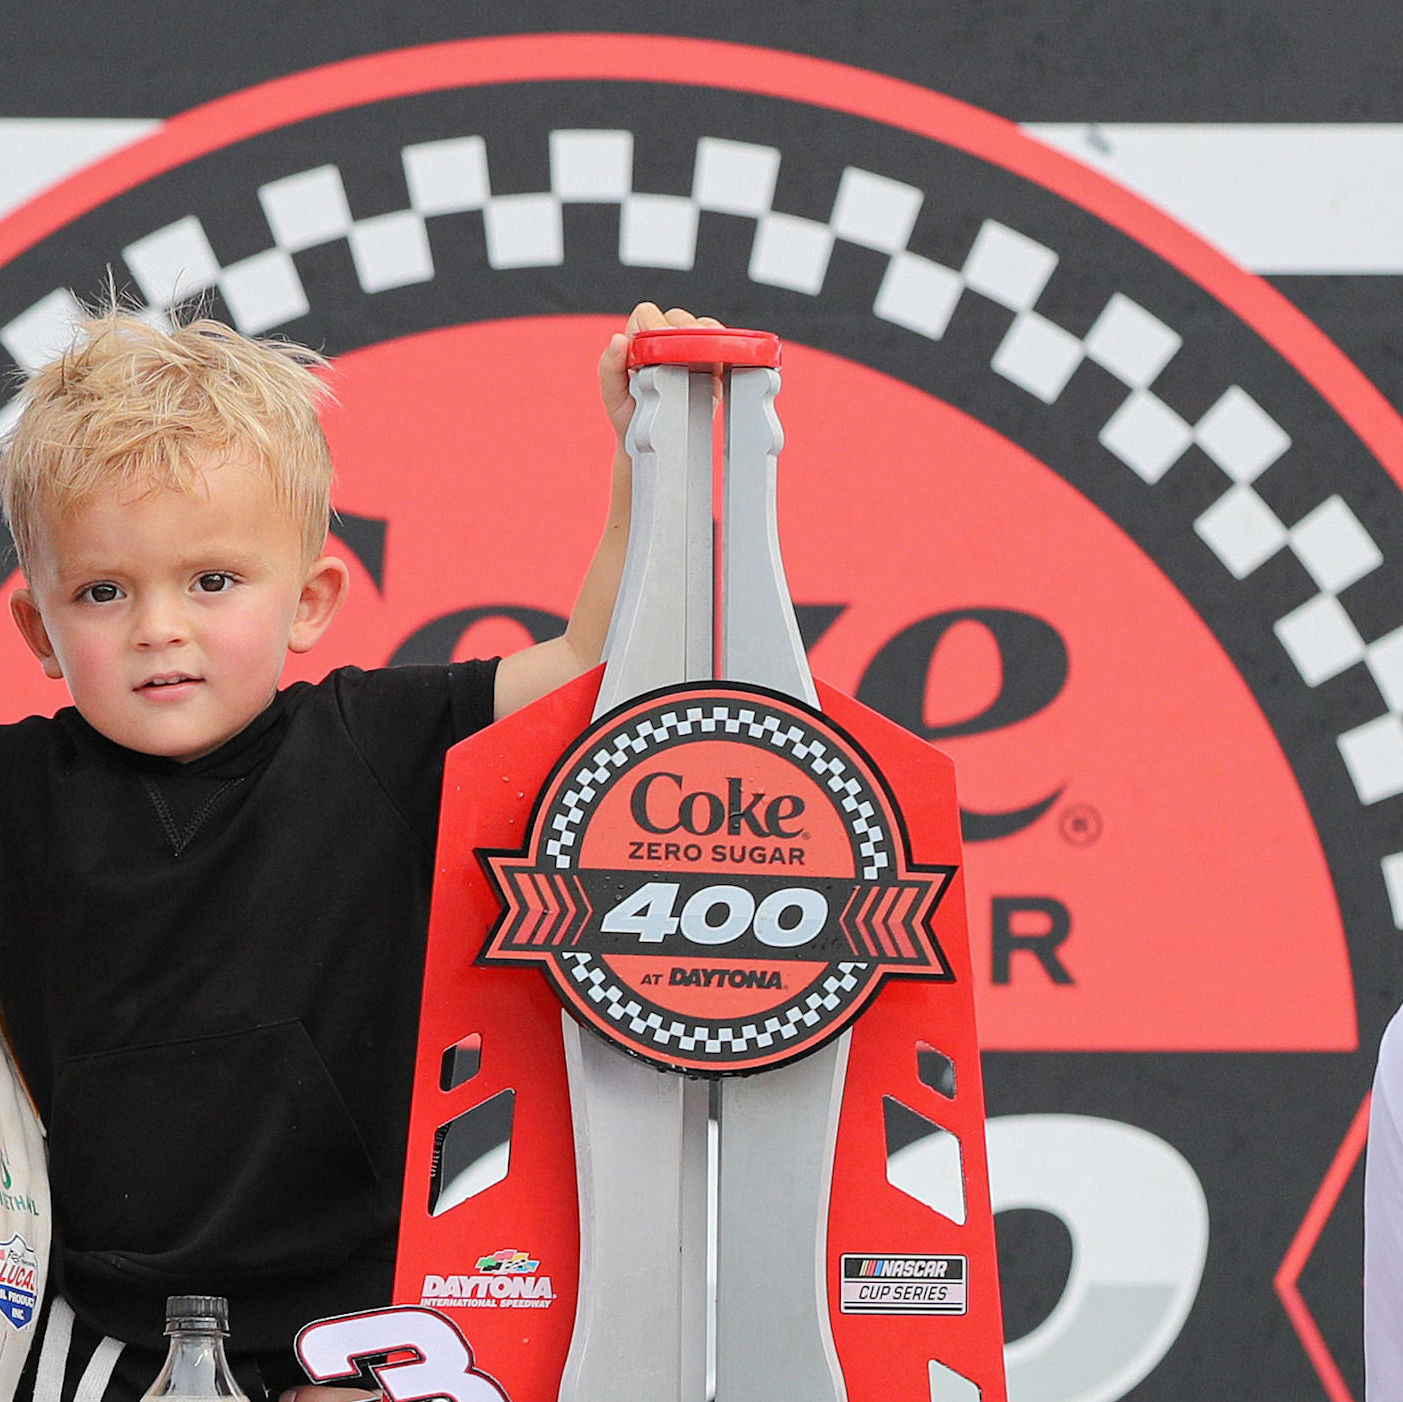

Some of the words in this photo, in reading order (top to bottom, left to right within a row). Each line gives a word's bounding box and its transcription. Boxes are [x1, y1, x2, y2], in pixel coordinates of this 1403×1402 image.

[630, 771, 806, 839] Coke
[628, 841, 702, 863] ZERO
[711, 844, 805, 866] SUGAR
[600, 882, 829, 948] 400
[641, 973, 663, 985] AT
[668, 967, 783, 990] DAYTONA
[880, 1260, 948, 1278] NASCAR
[421, 1275, 553, 1299] DAYTONA
[858, 1285, 891, 1300] CUP
[893, 1286, 949, 1300] SERIES
[420, 1298, 498, 1307] INTERNATIONAL
[499, 1299, 552, 1308] SPEEDWAY
